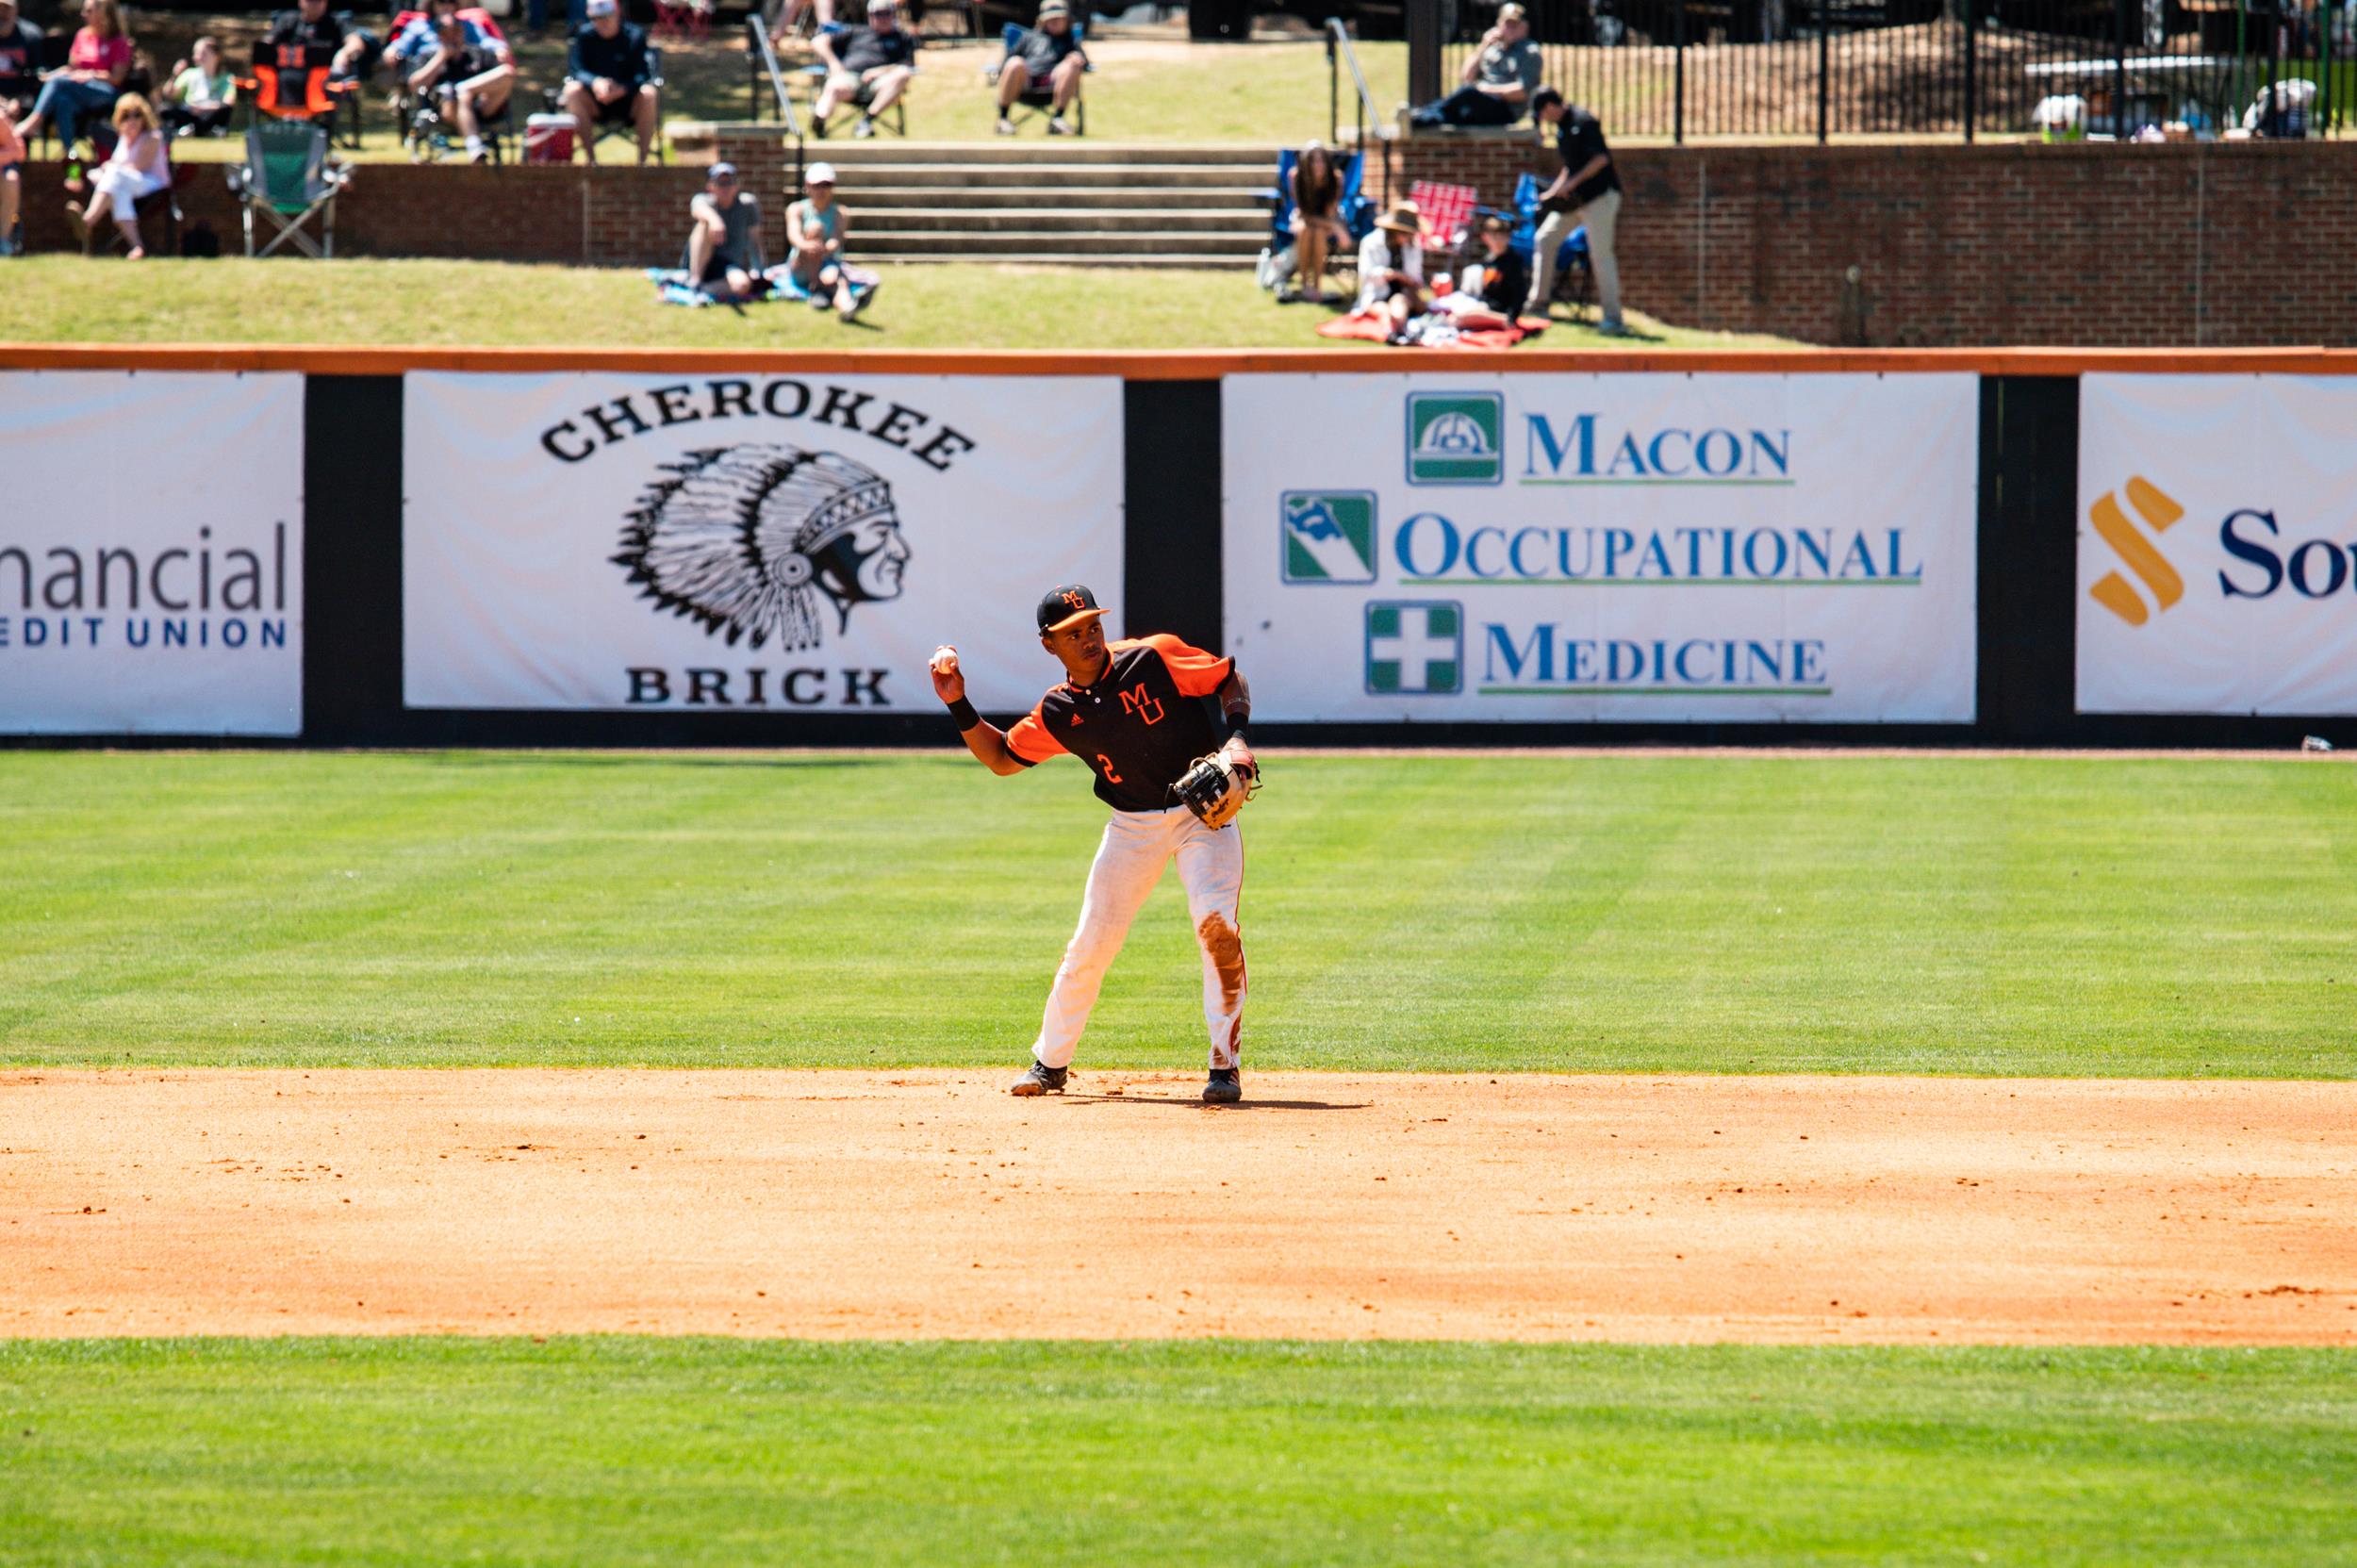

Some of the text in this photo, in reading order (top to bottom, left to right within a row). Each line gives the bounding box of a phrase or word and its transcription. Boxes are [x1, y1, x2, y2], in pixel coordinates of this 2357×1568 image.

[540, 379, 977, 473] CHEROKEE
[1521, 413, 1792, 476] MACON
[0, 520, 286, 611] nancial
[1394, 513, 1924, 580] OCCUPATIONAL
[1062, 590, 1085, 610] MU
[126, 618, 286, 648] UNION
[1481, 621, 1827, 684] MEDICINE
[625, 667, 892, 706] BRICK
[1118, 683, 1165, 726] MU
[1096, 753, 1123, 784] 2
